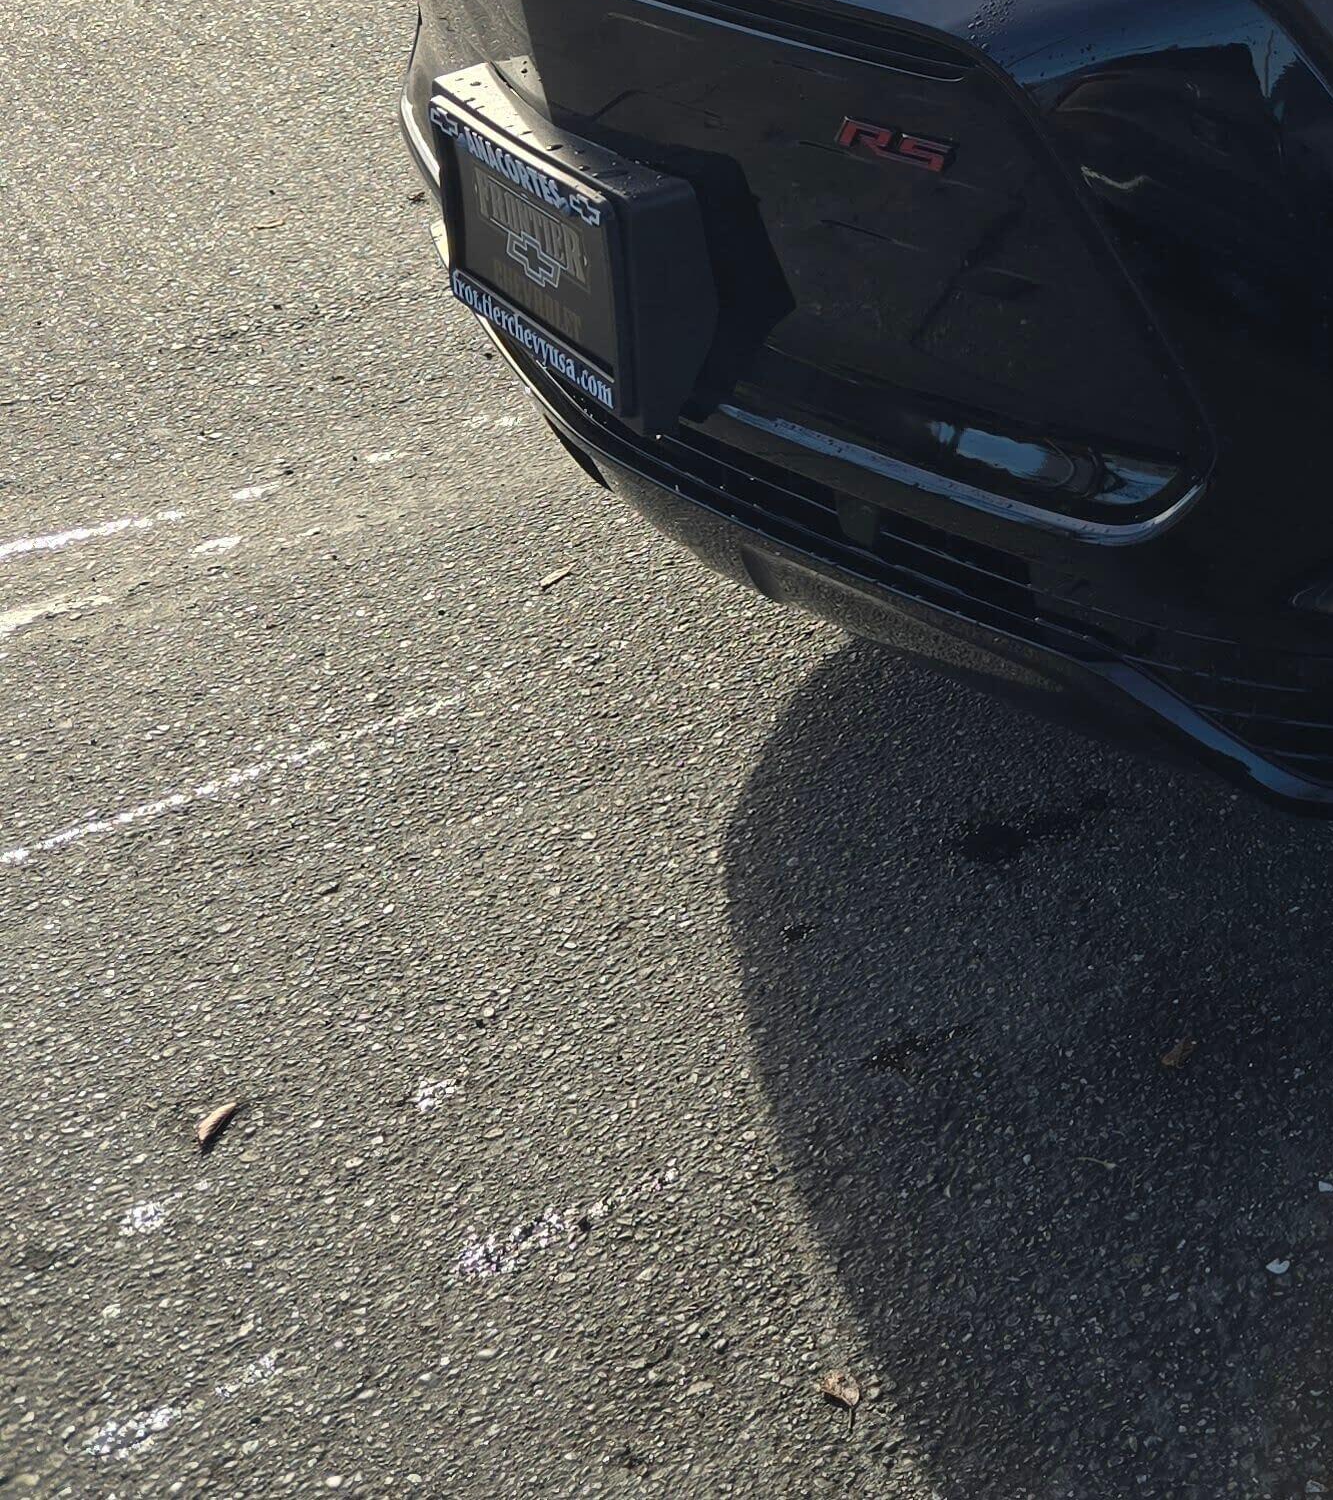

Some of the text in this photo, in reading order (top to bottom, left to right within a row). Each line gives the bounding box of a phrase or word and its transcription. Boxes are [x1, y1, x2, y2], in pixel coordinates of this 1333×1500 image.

[464, 127, 562, 208] ANACORTES
[834, 116, 952, 172] RS
[475, 167, 587, 283] FRONTIER
[452, 270, 615, 410] frontierchevyusa.com
